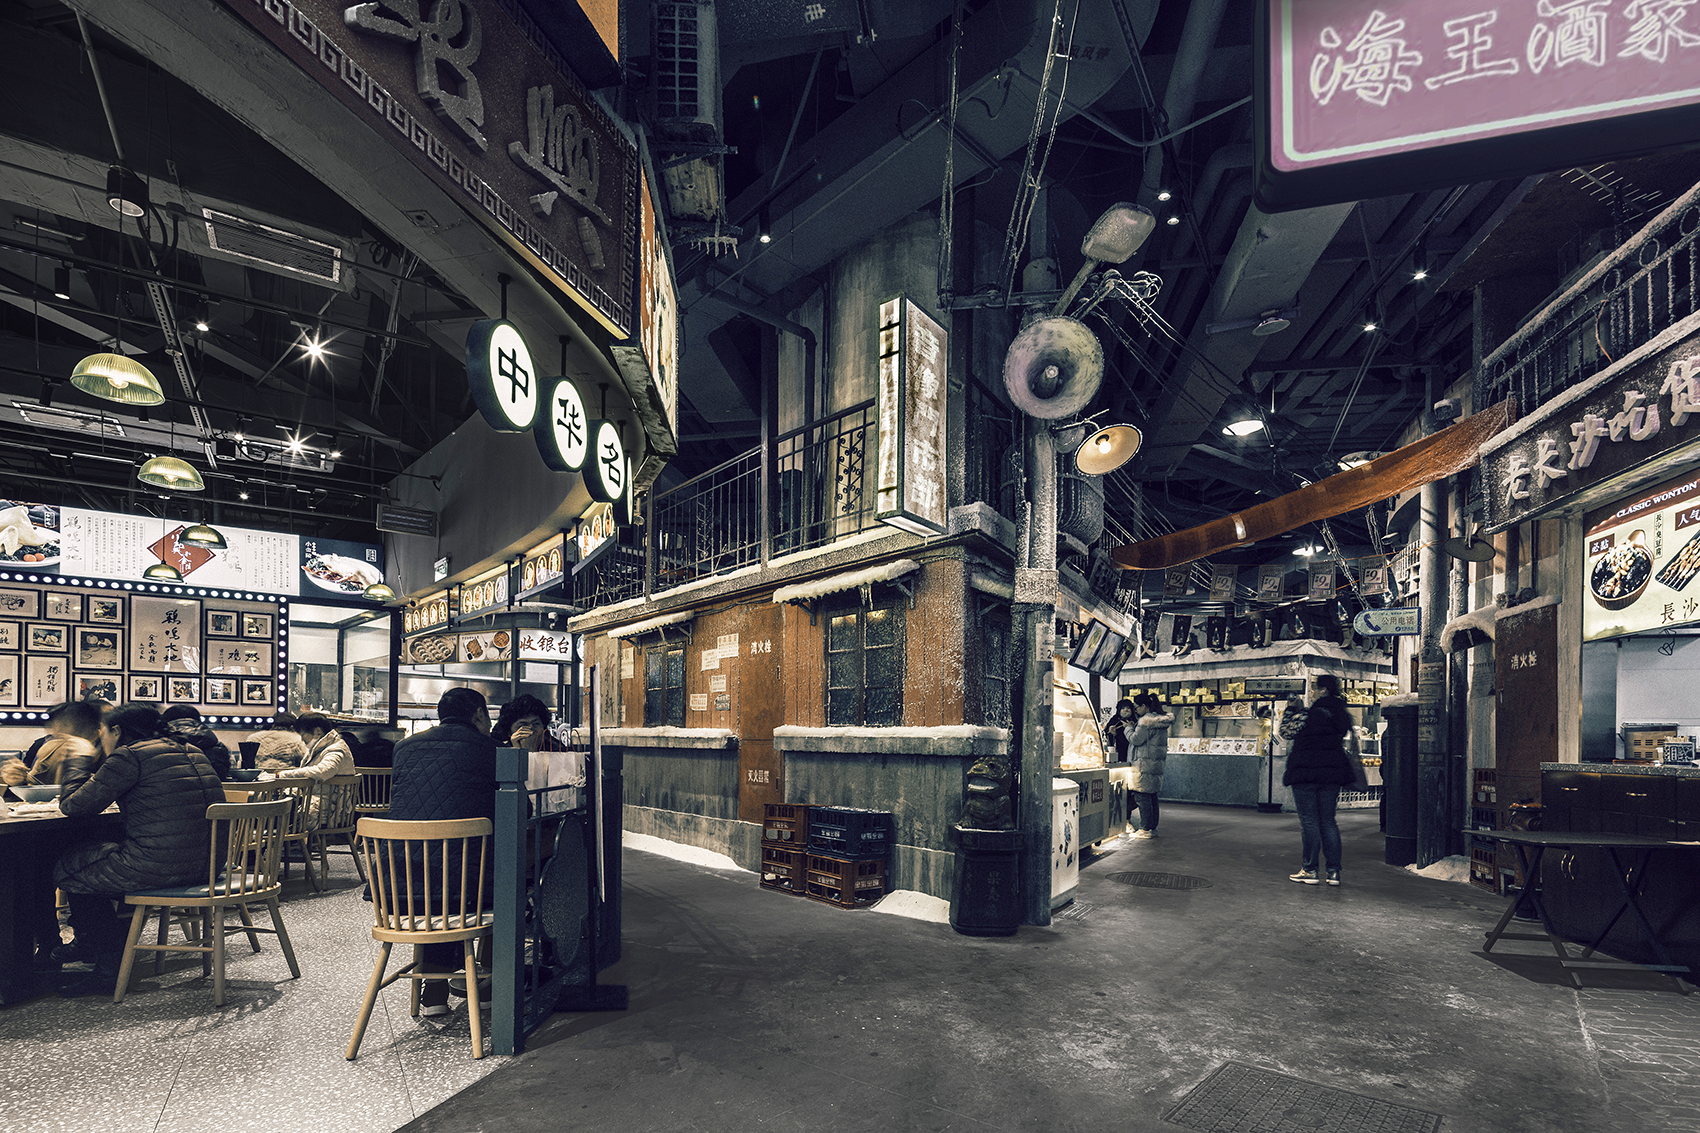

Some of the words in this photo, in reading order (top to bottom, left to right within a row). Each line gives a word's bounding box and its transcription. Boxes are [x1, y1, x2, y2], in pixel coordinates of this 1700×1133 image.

[1616, 500, 1652, 518] CLASSIC
[1653, 481, 1698, 505] WONTON
[1381, 615, 1415, 625] 公用电话
[520, 634, 570, 654] 收银台
[751, 640, 771, 654] 消火栓
[1510, 653, 1537, 670] 消火栓
